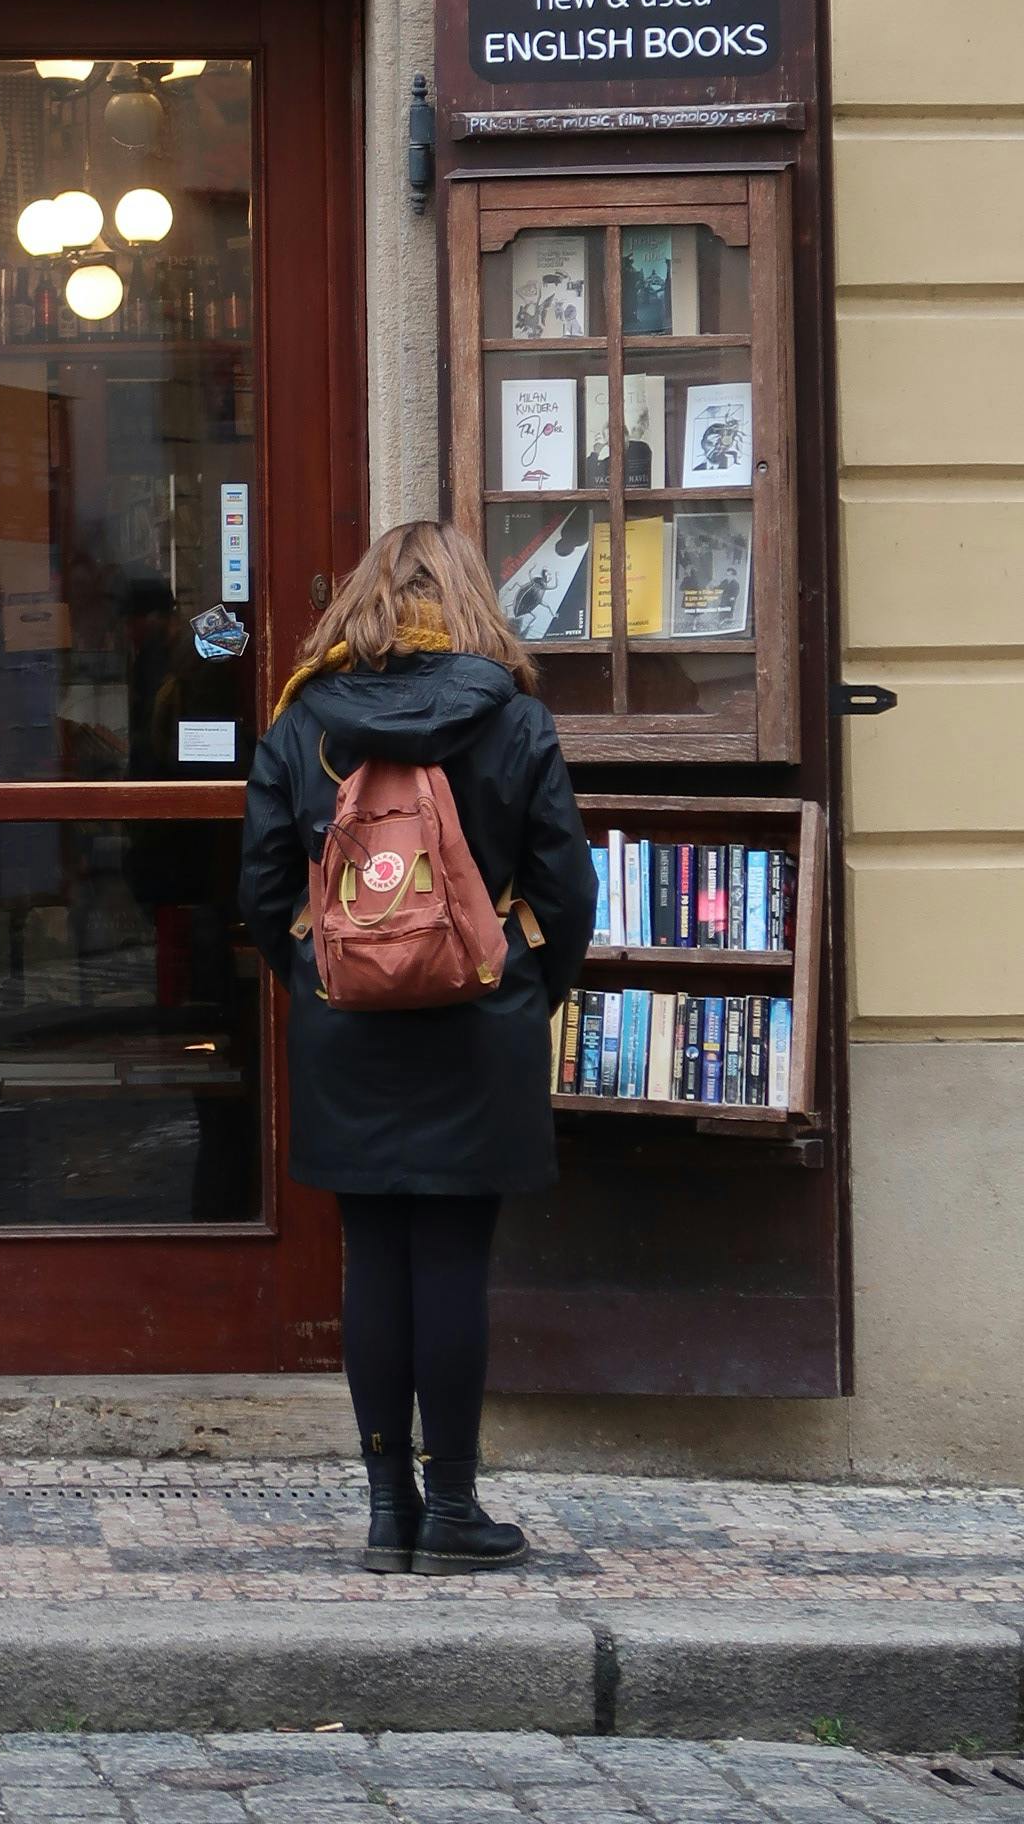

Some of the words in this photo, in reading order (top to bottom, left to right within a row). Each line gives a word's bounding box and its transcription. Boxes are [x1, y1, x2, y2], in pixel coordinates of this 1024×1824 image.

[485, 27, 633, 64] ENGLISH
[644, 23, 768, 59] BOOKS
[519, 392, 547, 403] MILAN
[516, 403, 559, 415] KUNDERA
[681, 895, 689, 905] PO
